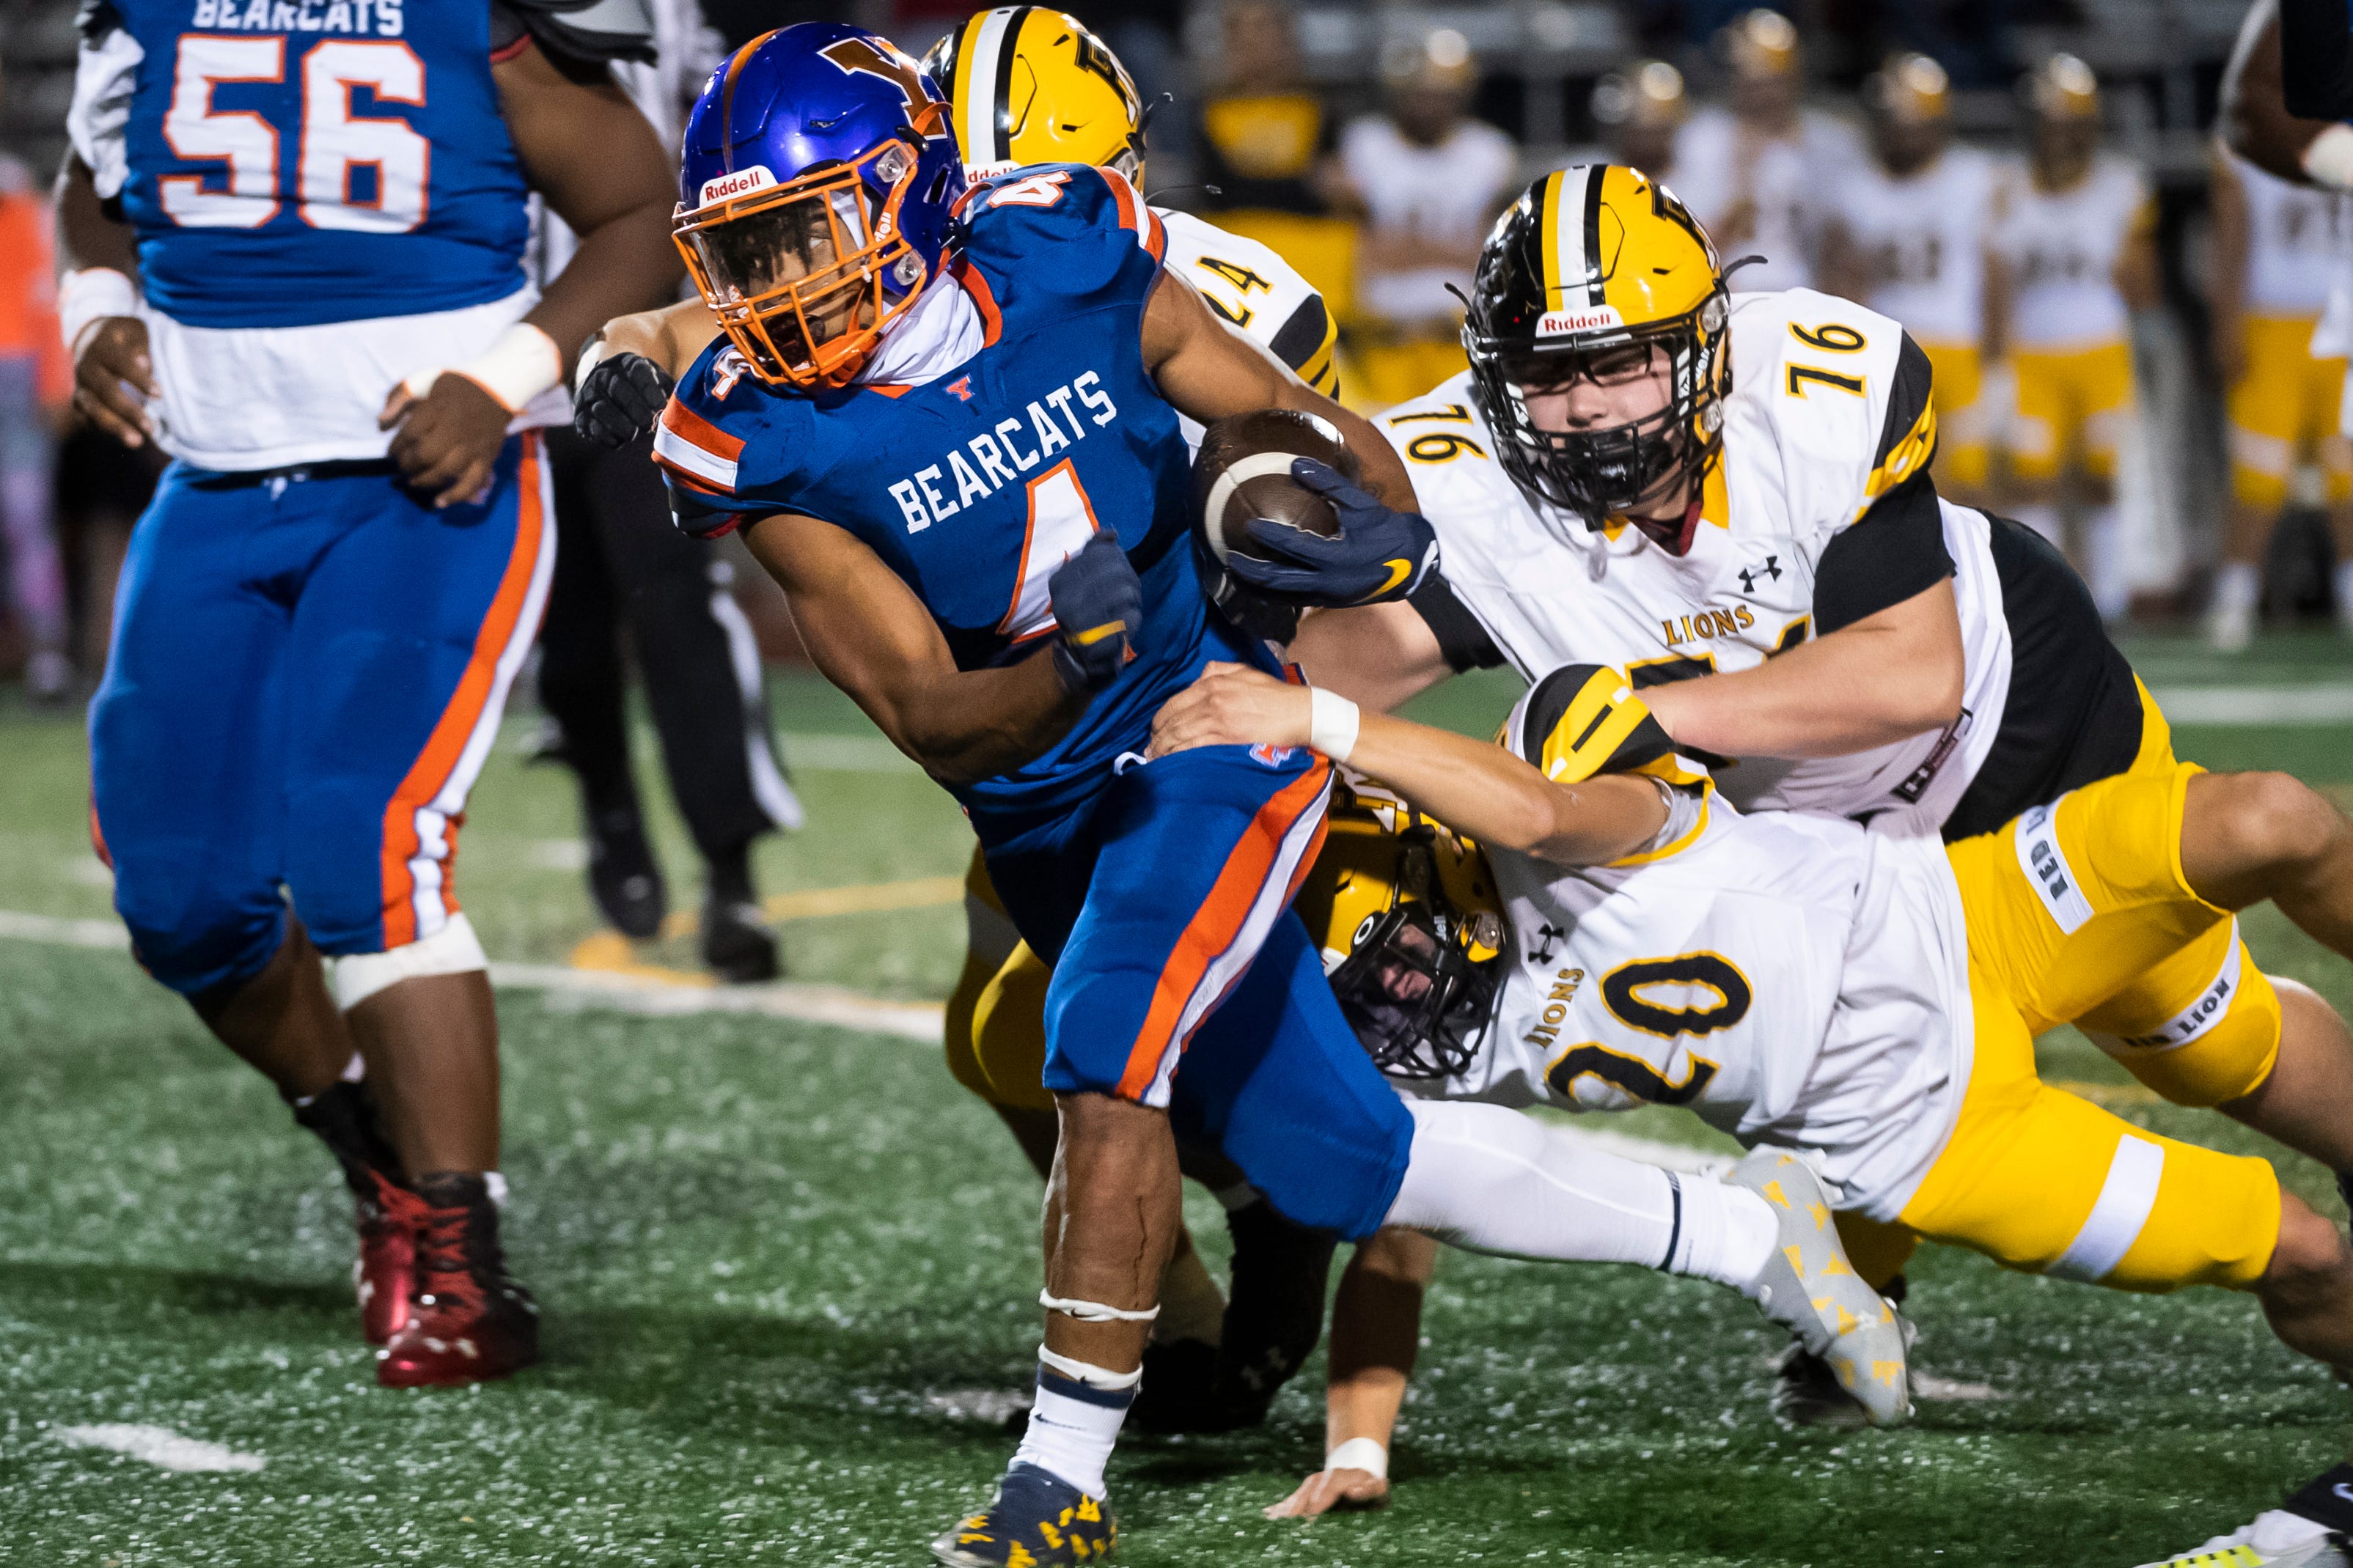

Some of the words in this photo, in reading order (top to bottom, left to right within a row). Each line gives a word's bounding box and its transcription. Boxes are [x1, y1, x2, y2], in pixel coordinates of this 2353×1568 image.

[157, 32, 432, 234] 56
[705, 171, 760, 201] Riddell
[987, 170, 1073, 208] 4
[1544, 313, 1610, 332] Riddell
[1785, 320, 1868, 402] 76
[888, 370, 1117, 534] BEARCATS
[1387, 404, 1489, 465] 76
[1661, 604, 1755, 647] LIONS
[1523, 968, 1585, 1050] LIONS
[1543, 949, 1753, 1113] 20
[2177, 977, 2231, 1035] LION
